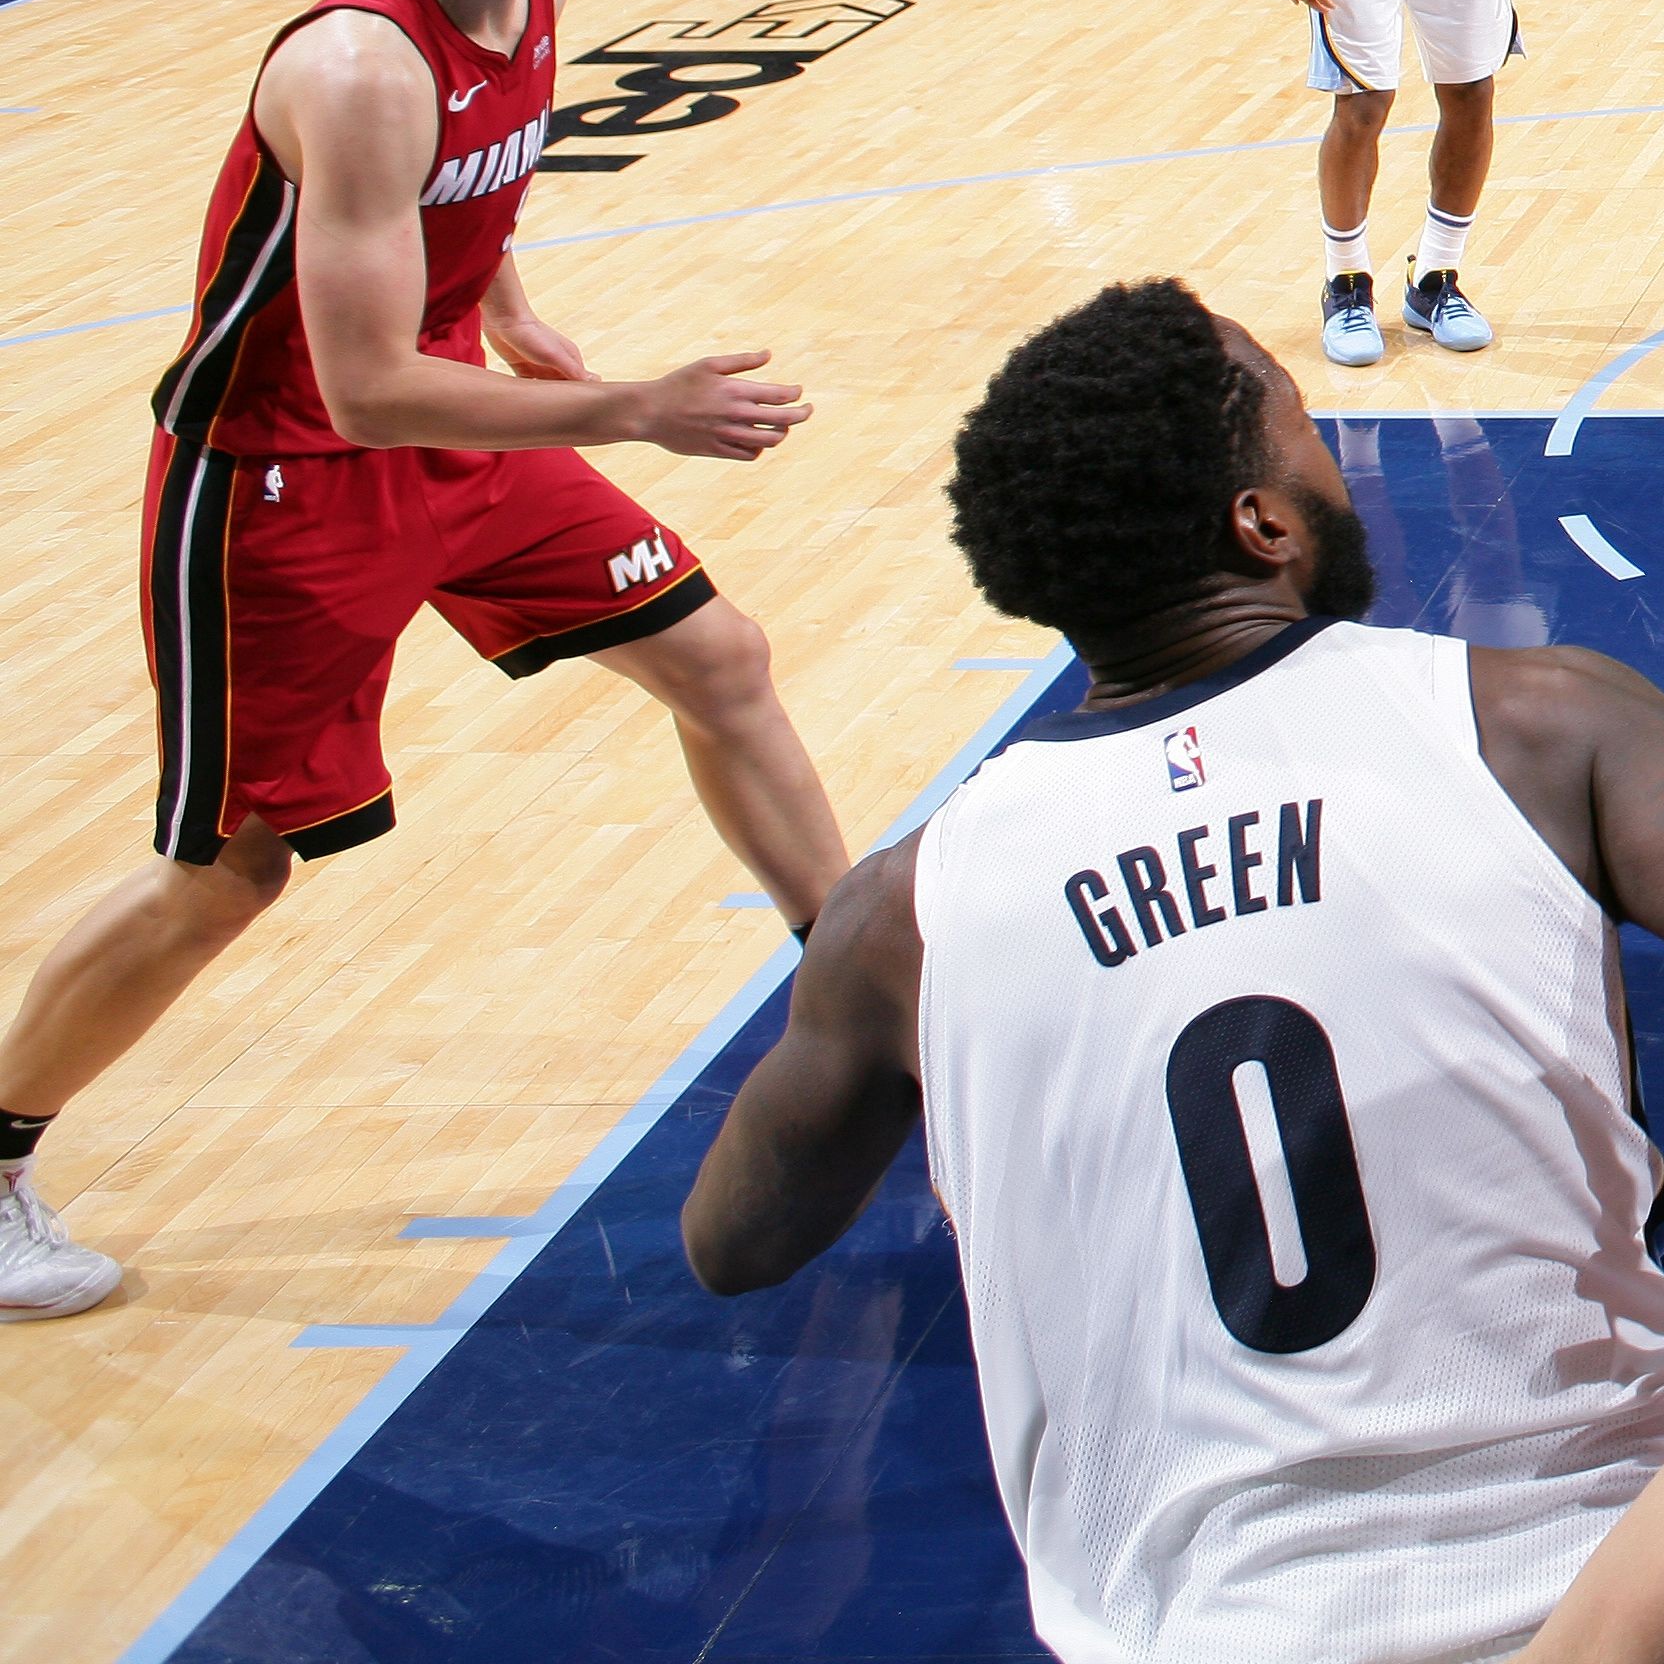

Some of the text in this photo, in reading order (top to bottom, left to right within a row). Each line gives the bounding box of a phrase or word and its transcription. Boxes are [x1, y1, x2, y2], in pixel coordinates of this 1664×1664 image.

[419, 98, 549, 206] MIAM
[1064, 798, 1324, 969] GREEN
[1165, 993, 1378, 1355] 0
